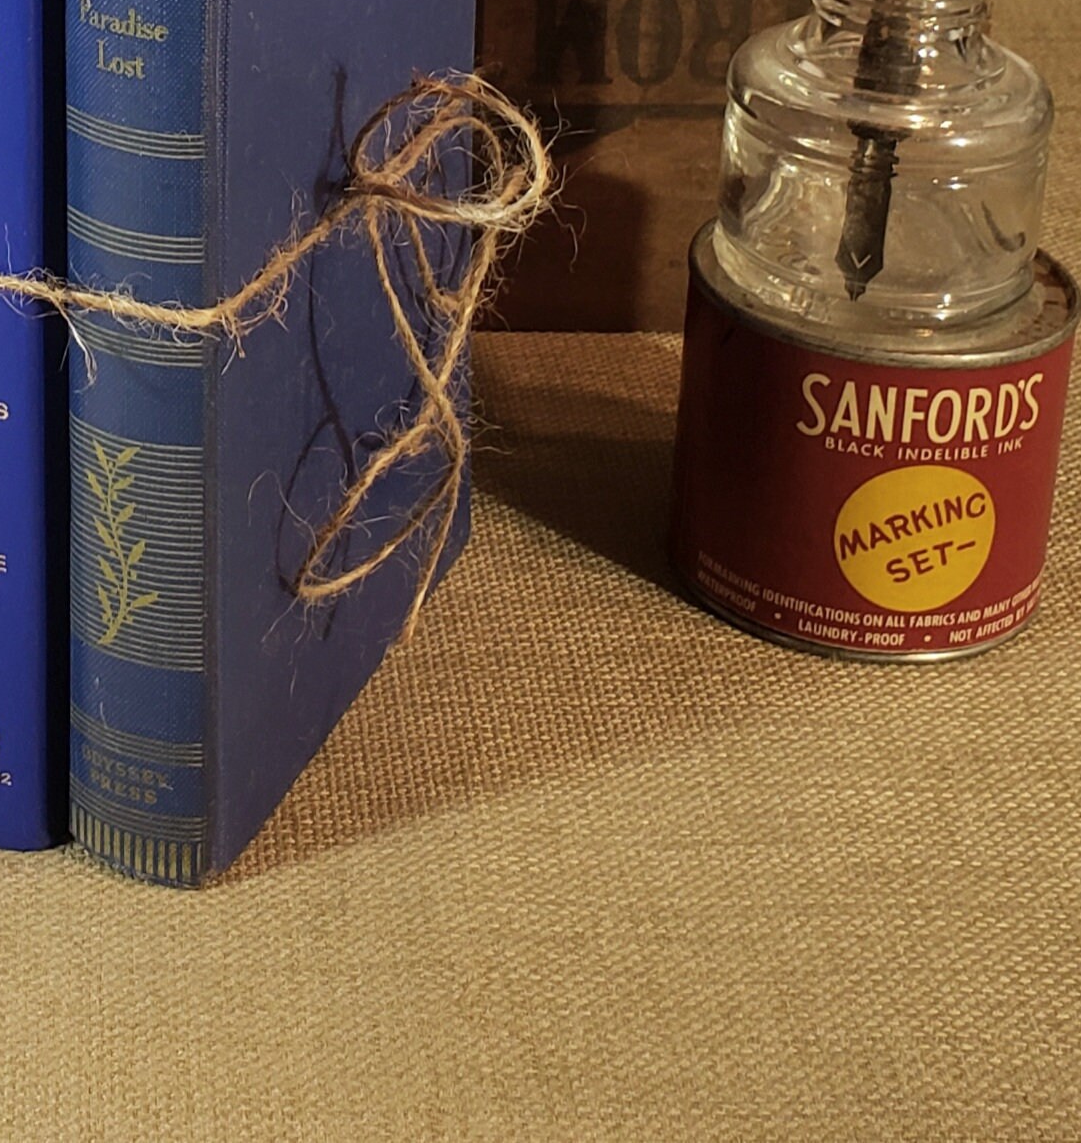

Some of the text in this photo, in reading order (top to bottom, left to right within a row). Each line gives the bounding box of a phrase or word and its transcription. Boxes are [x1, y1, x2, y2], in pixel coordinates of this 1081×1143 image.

[96, 37, 146, 80] Lost
[796, 372, 1044, 445] SANFORD'S
[824, 435, 1024, 461] BLACK INDELIBLE INK
[839, 492, 987, 561] MARKING
[762, 588, 861, 626] IDENTIFICATIONS
[862, 614, 883, 628] ON
[885, 615, 906, 629] ALL
[909, 613, 956, 629] FABRICS
[957, 609, 982, 625] AND
[982, 597, 1012, 620] MANY
[948, 627, 974, 644] NOT
[975, 613, 1015, 639] AFFECTED
